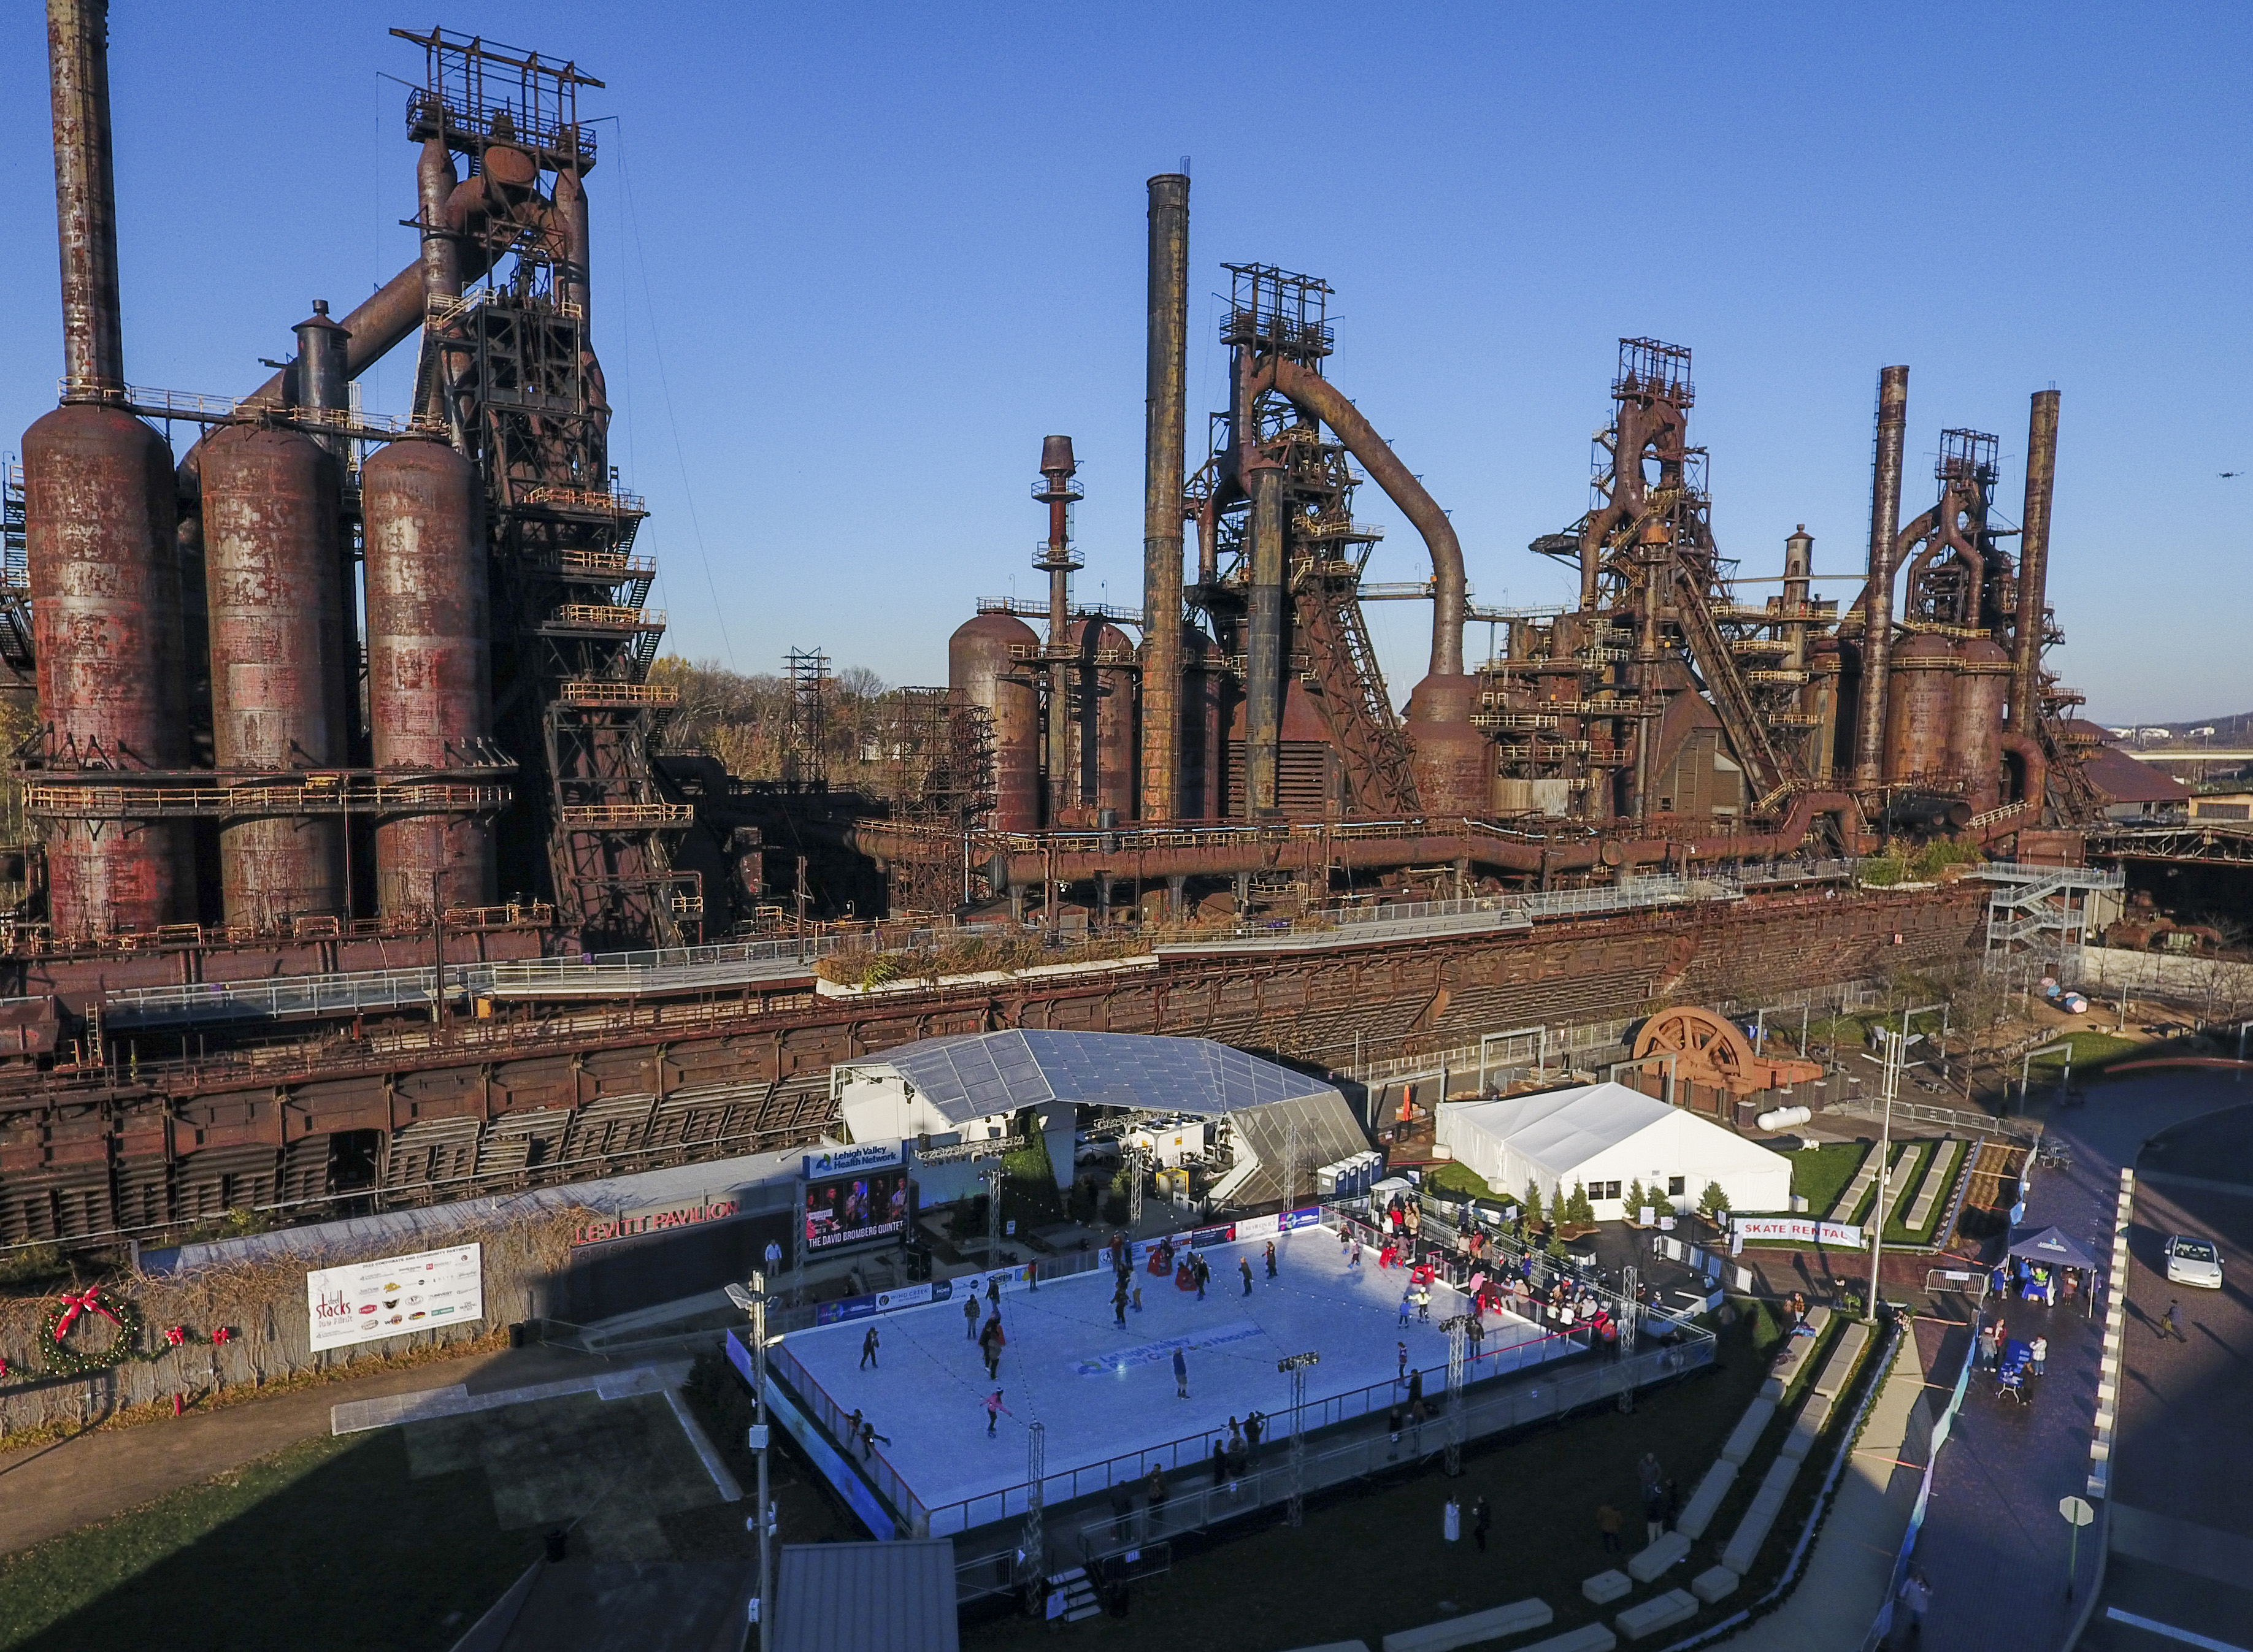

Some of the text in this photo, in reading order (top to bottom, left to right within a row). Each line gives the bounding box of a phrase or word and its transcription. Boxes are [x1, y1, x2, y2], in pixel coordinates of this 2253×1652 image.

[834, 1146, 887, 1160] Lehigh Valley
[834, 1152, 896, 1169] Health Network
[576, 1201, 740, 1244] LEVITT PAVILION
[809, 1220, 904, 1247] THE DAVID BROMBERG QUINTET
[1744, 1225, 1848, 1239] SKATE RENTAL
[316, 1290, 351, 1319] stacks
[328, 1290, 340, 1305] steel
